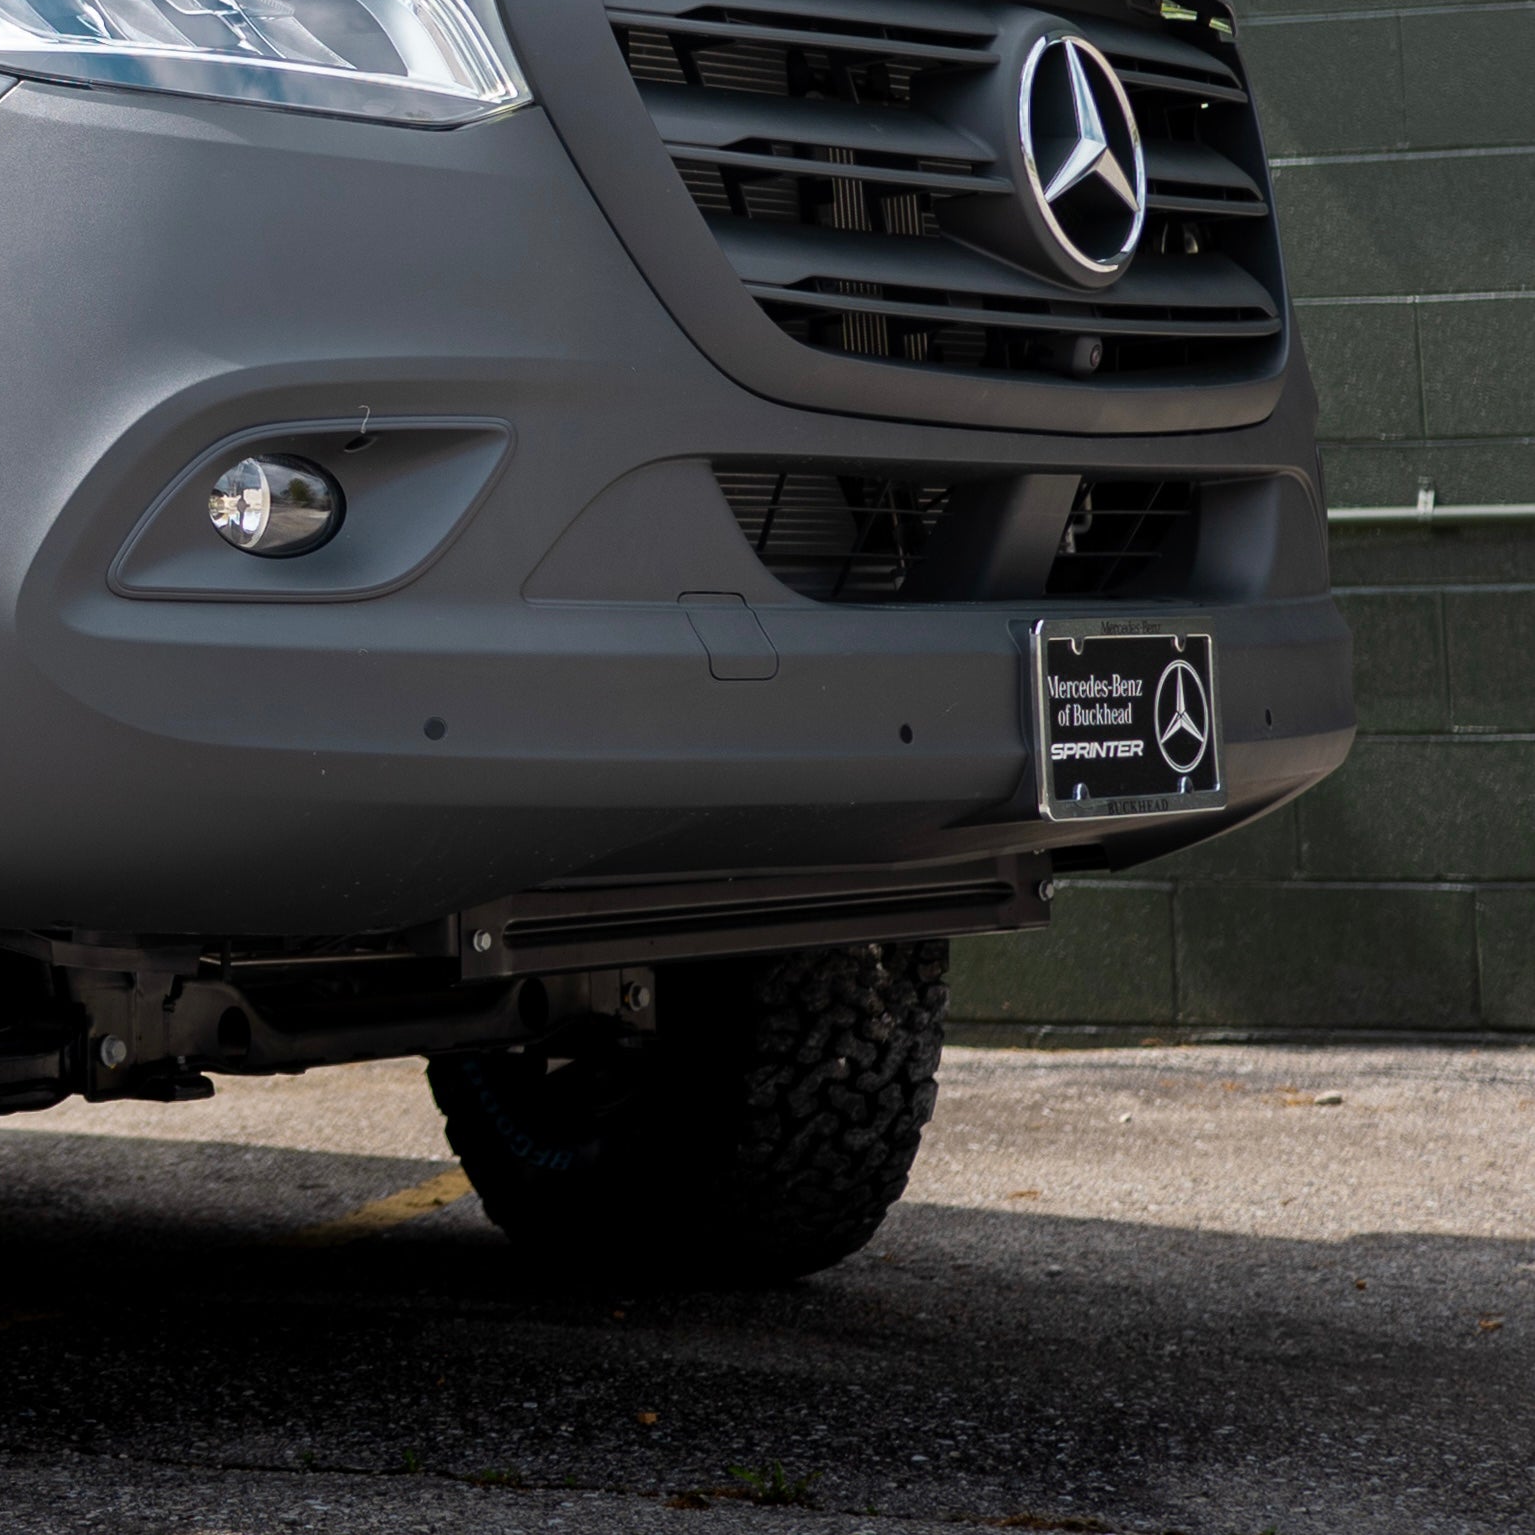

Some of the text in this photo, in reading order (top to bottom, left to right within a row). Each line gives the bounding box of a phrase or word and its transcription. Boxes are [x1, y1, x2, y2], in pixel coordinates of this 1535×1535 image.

[1048, 673, 1143, 699] Mercedes-Benz
[1058, 702, 1133, 726] of Buckhead
[1050, 739, 1145, 761] SPRINTER
[1107, 799, 1169, 814] BUCKHEAD
